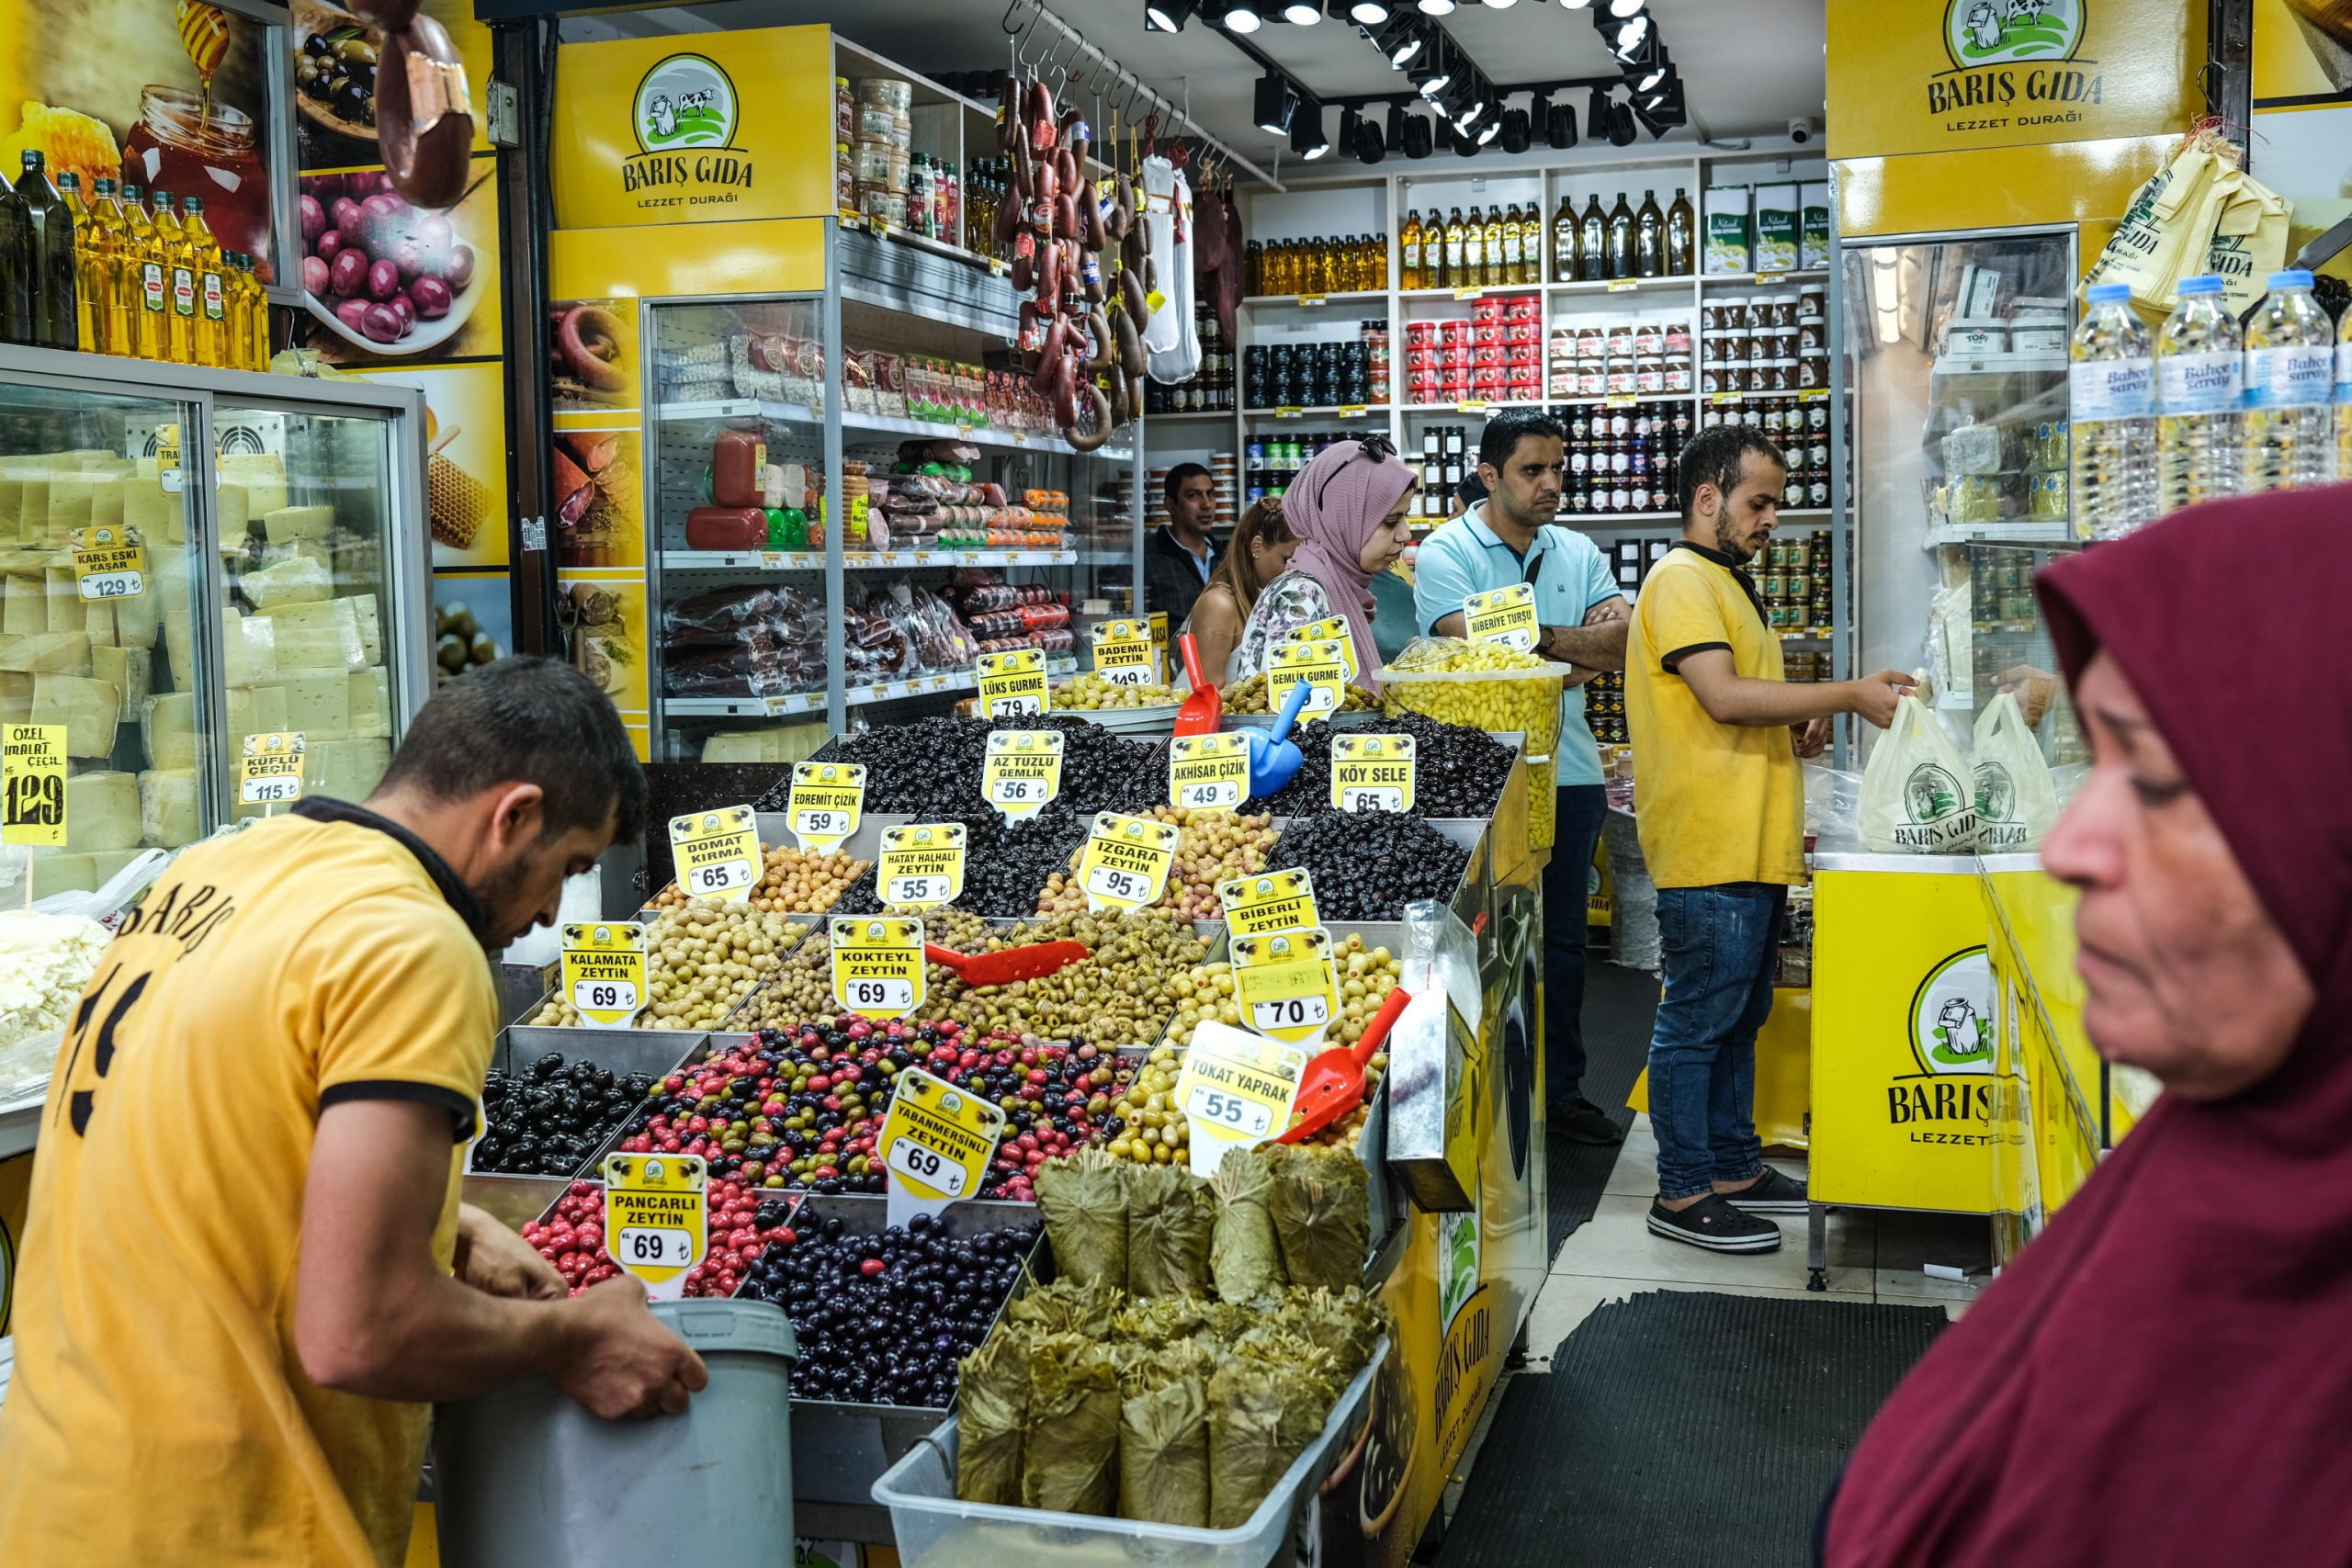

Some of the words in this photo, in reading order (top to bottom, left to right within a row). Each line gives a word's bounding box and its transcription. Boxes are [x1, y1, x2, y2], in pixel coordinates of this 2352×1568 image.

[1928, 71, 2016, 115] BARIŞ
[2027, 70, 2103, 105] GIDA
[1947, 118, 2010, 131] LEZZET
[2018, 109, 2082, 127] DURAĞI
[622, 156, 688, 193] BARIŞ
[695, 155, 752, 188] GIDA
[638, 197, 684, 209] LEZZET
[690, 192, 738, 205] DURAĞI
[78, 553, 108, 564] KARS
[111, 548, 137, 560] ESKİ
[90, 561, 128, 571] KAŞAR
[96, 580, 127, 596] 129
[1472, 615, 1506, 633] BİBERİYE
[1507, 609, 1532, 624] TURŞU
[1098, 642, 1148, 656] BADEMLİ
[1104, 653, 1144, 665] ZEYTİN
[1112, 672, 1138, 686] 149
[1307, 670, 1339, 682] GURME
[984, 681, 1007, 695] LÜKS
[1010, 678, 1043, 693] GURME
[1001, 700, 1023, 716] 79
[13, 726, 46, 741] ÖZEL
[248, 755, 299, 766] KÜFLÜ
[249, 764, 296, 775] ÇEÇİL
[993, 757, 1010, 767] AZ
[1014, 757, 1055, 767] TUZLU
[1174, 763, 1216, 780] AKHİSAR
[1219, 759, 1245, 780] ÇİZİK
[999, 767, 1045, 777] GEMLİK
[1340, 764, 1367, 783] KÖY
[1372, 768, 1407, 783] SELE
[256, 784, 283, 800] 115
[1002, 782, 1027, 798] 56
[1193, 786, 1217, 804] 49
[3, 774, 63, 827] 129
[795, 792, 832, 806] EDREMİT
[834, 793, 857, 808] ÇİZİK
[1356, 793, 1381, 811] 65
[809, 813, 831, 831] 59
[1946, 814, 1975, 839] GID
[687, 836, 743, 853] DOMAT
[1097, 841, 1159, 863] IZGARA
[691, 847, 743, 863] KIRMA
[888, 854, 916, 864] HATAY
[918, 851, 956, 863] HALHALİ
[1102, 855, 1150, 873] ZEYTİN
[703, 866, 729, 886] 65
[898, 863, 944, 874] ZEYTİN
[902, 879, 928, 899] 55
[1106, 872, 1133, 896] 95
[1240, 899, 1301, 920] BİBERLİ
[1248, 914, 1300, 933] ZEYTİN
[571, 954, 637, 966] KALAMATA
[842, 953, 914, 962] KOKTEYL
[850, 964, 907, 975] ZEYTİN
[593, 987, 616, 1006] 69
[858, 983, 885, 1003] 69
[1271, 1000, 1305, 1023] 70
[1192, 1059, 1234, 1084] TOKAT
[1237, 1073, 1290, 1103] YAPRAK
[1205, 1093, 1243, 1122] 55
[1888, 1083, 1994, 1128] BARIŞ
[898, 1105, 988, 1156] YABANMERSİNLİ
[1911, 1132, 1989, 1146] LEZZET
[907, 1125, 967, 1161] ZEYTİN
[908, 1148, 940, 1176] 69
[616, 1196, 695, 1211] PANCARLI
[627, 1211, 684, 1225] ZEYTİN
[634, 1235, 662, 1259] 69
[1434, 1333, 1461, 1447] BARIŞ
[1464, 1307, 1490, 1374] GIDA
